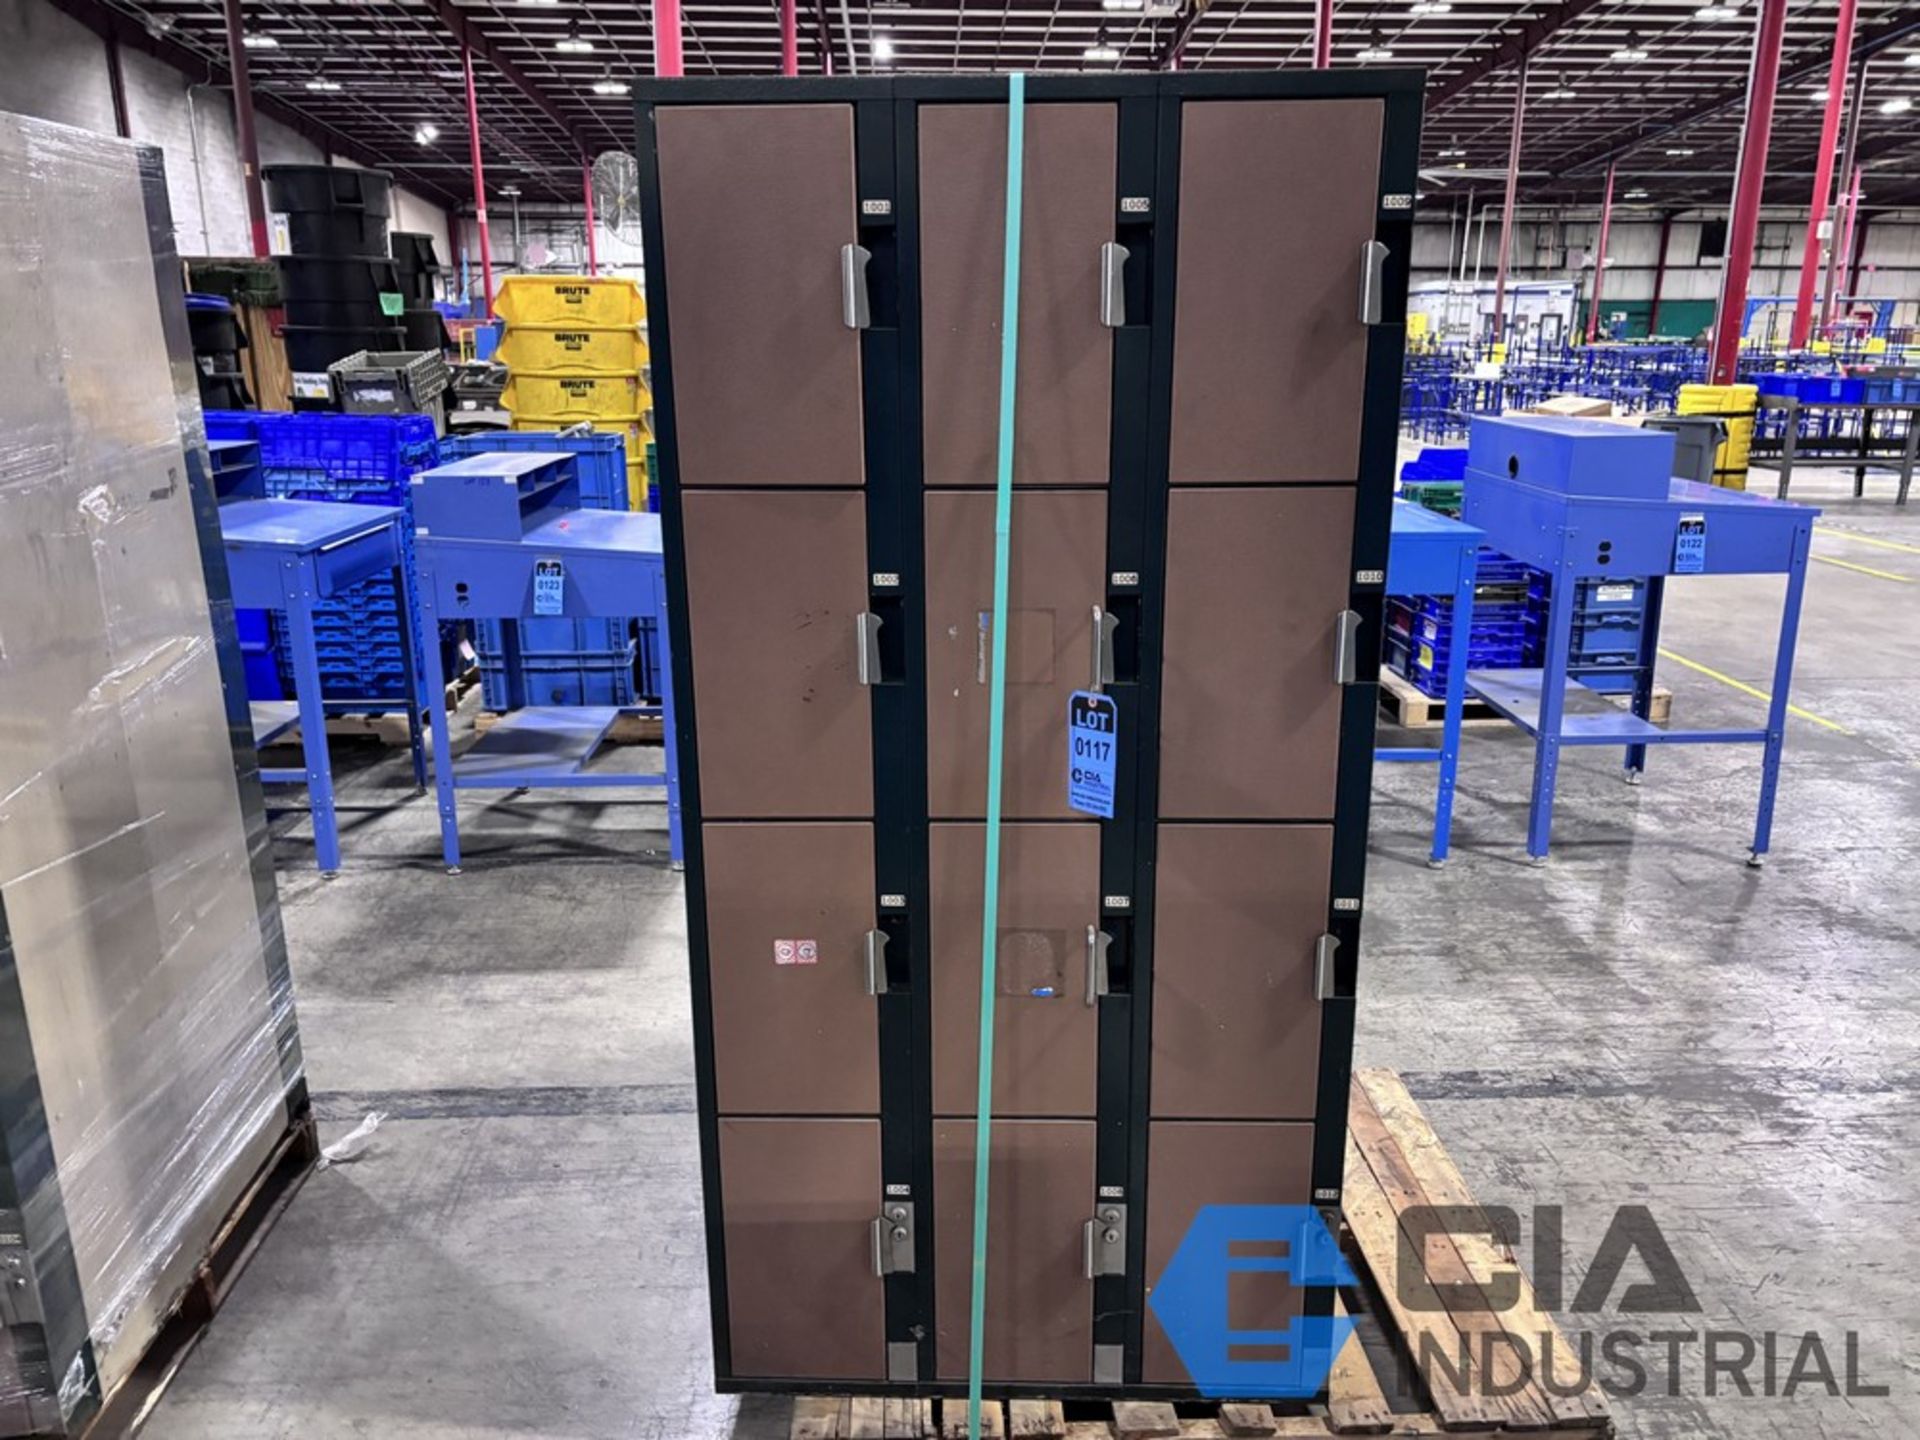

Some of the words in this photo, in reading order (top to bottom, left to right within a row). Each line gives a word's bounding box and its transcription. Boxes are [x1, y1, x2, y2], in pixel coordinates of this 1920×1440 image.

[555, 286, 590, 295] BRUTE
[554, 333, 589, 342] BRUTE
[560, 380, 595, 389] BRUTE
[1681, 525, 1702, 536] LOT
[1680, 539, 1702, 548] 0122
[539, 567, 558, 577] LOT
[1076, 708, 1109, 730] LOT
[1075, 736, 1111, 762] 0117
